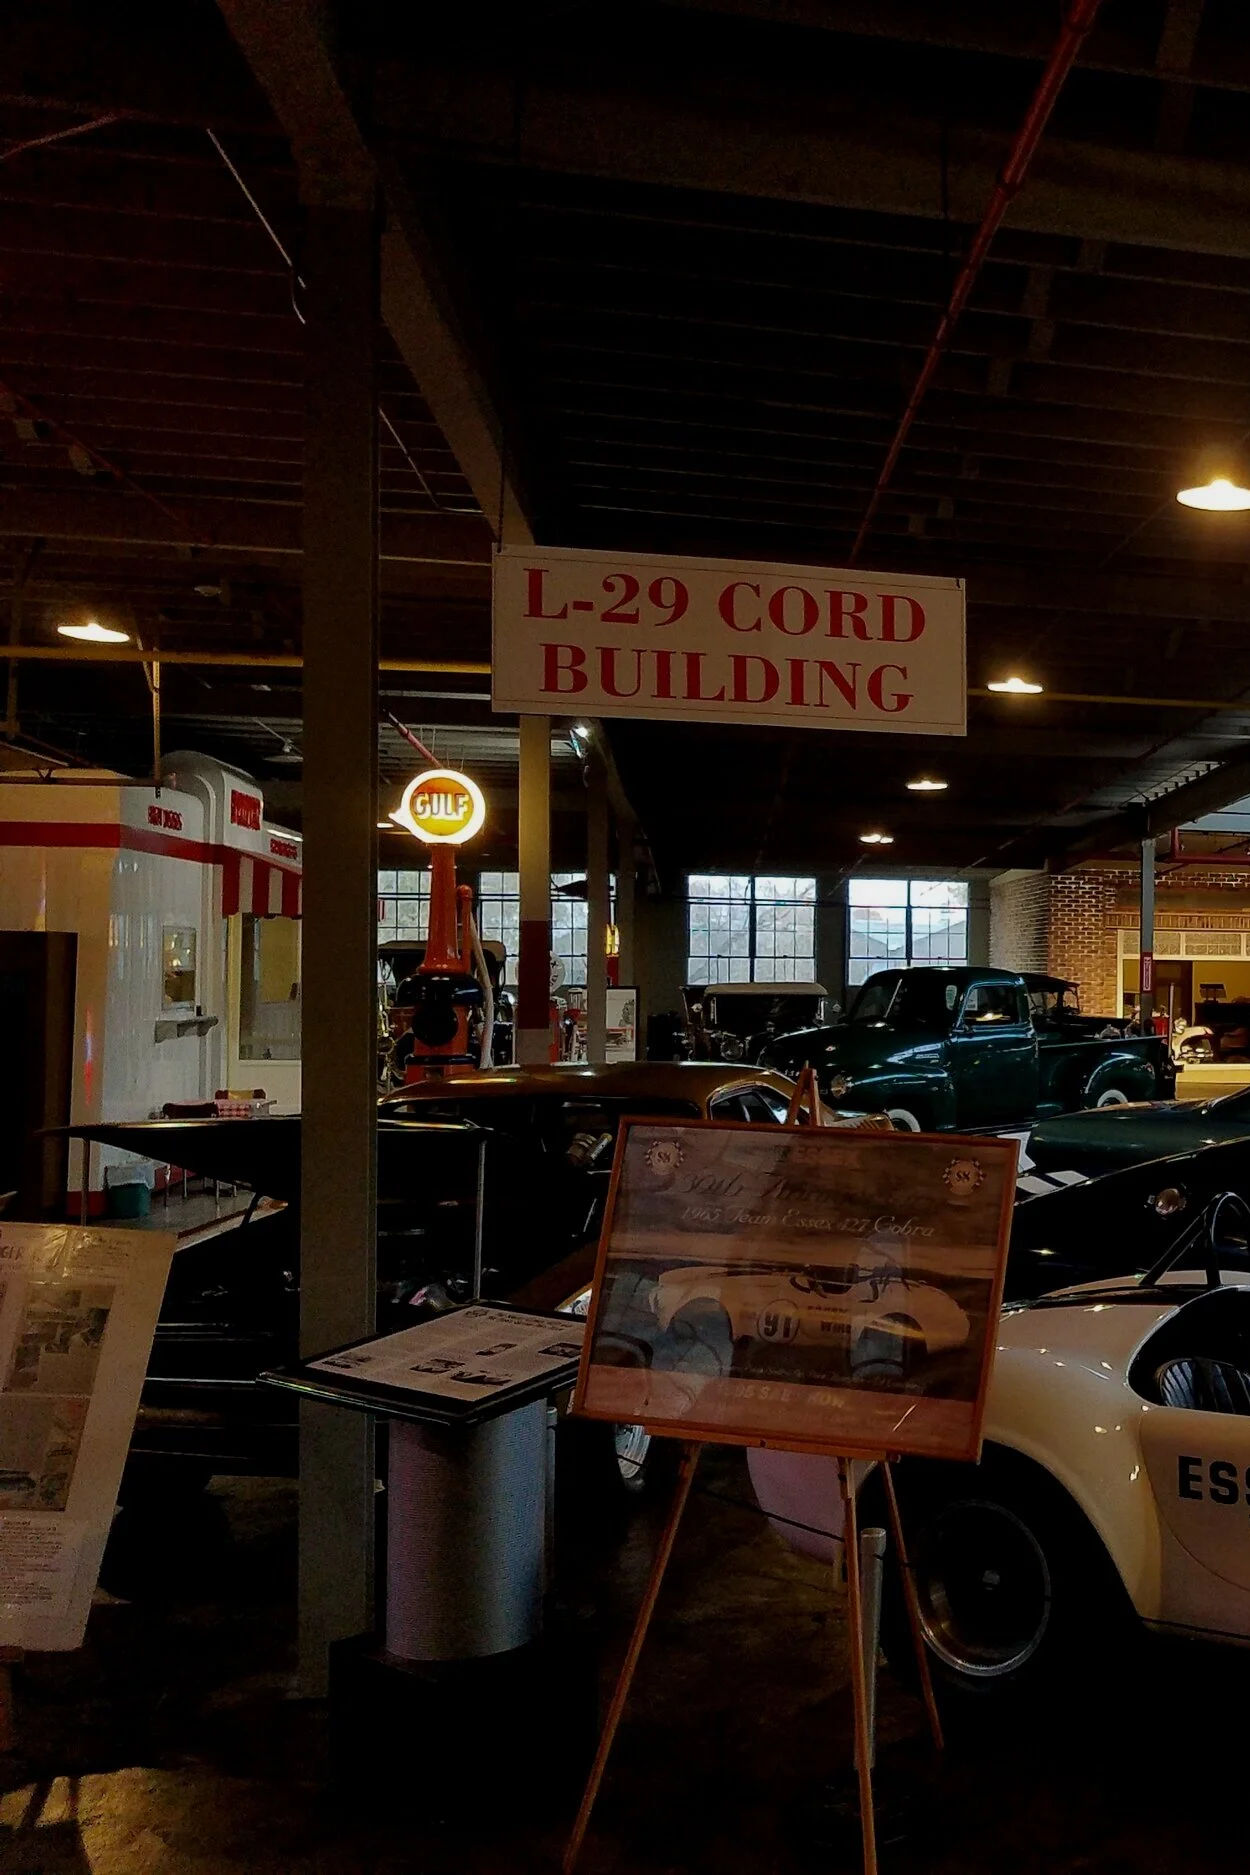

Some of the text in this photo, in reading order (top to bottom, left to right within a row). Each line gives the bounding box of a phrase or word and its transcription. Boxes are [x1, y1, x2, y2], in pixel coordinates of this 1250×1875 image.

[522, 567, 927, 643] L-29 CORD
[538, 643, 914, 713] BUILDING
[413, 791, 469, 821] GULF
[680, 1206, 936, 1238] 1965 Team Essex 427 Cobra
[763, 1311, 792, 1338] 91
